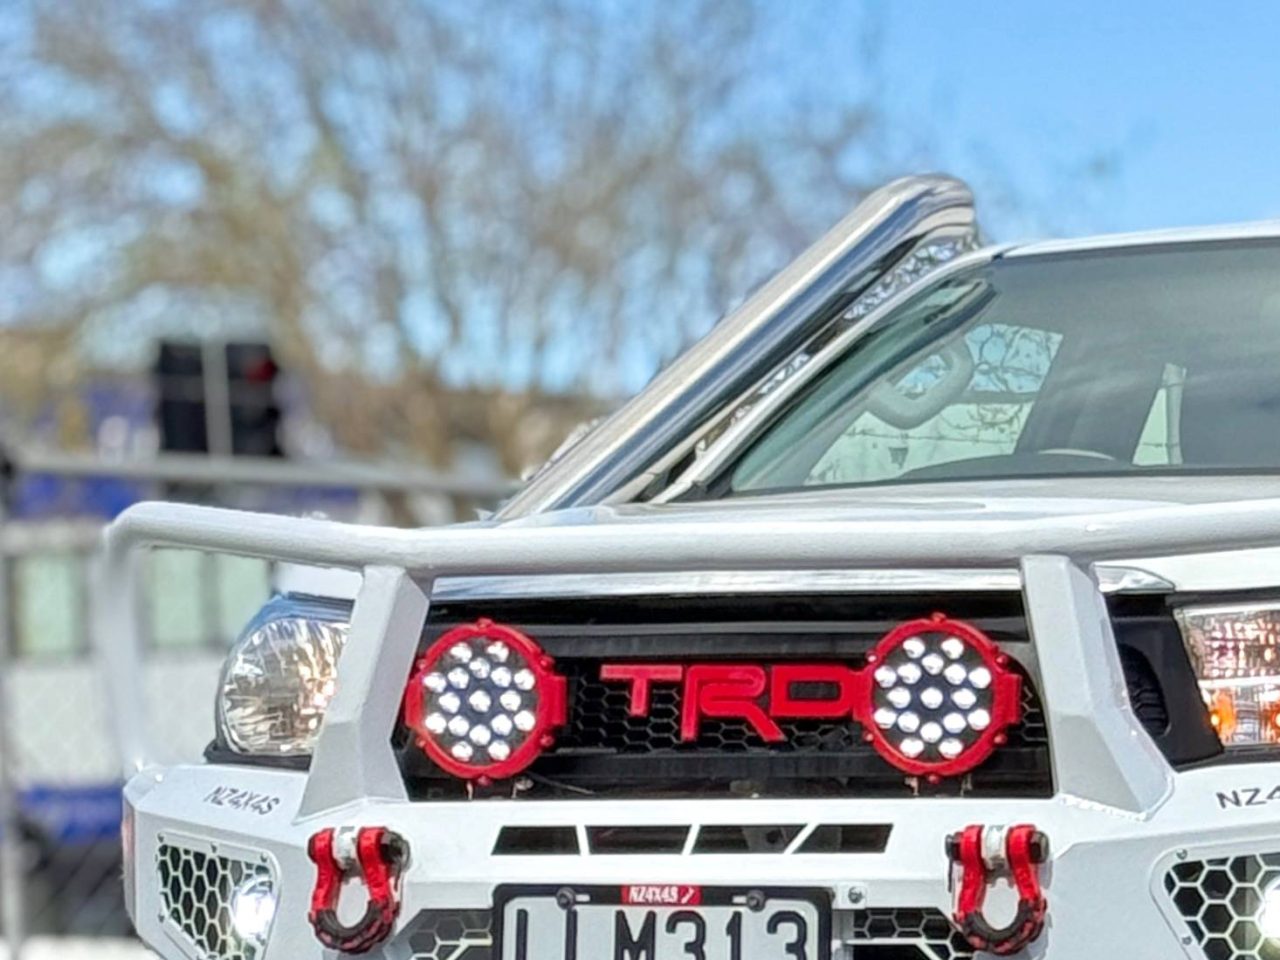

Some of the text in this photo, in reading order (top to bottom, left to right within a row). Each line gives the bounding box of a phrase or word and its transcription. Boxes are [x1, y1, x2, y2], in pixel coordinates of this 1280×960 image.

[600, 664, 860, 742] TRD
[203, 786, 280, 815] NZ4X4S
[629, 886, 679, 904] NZ4X4S
